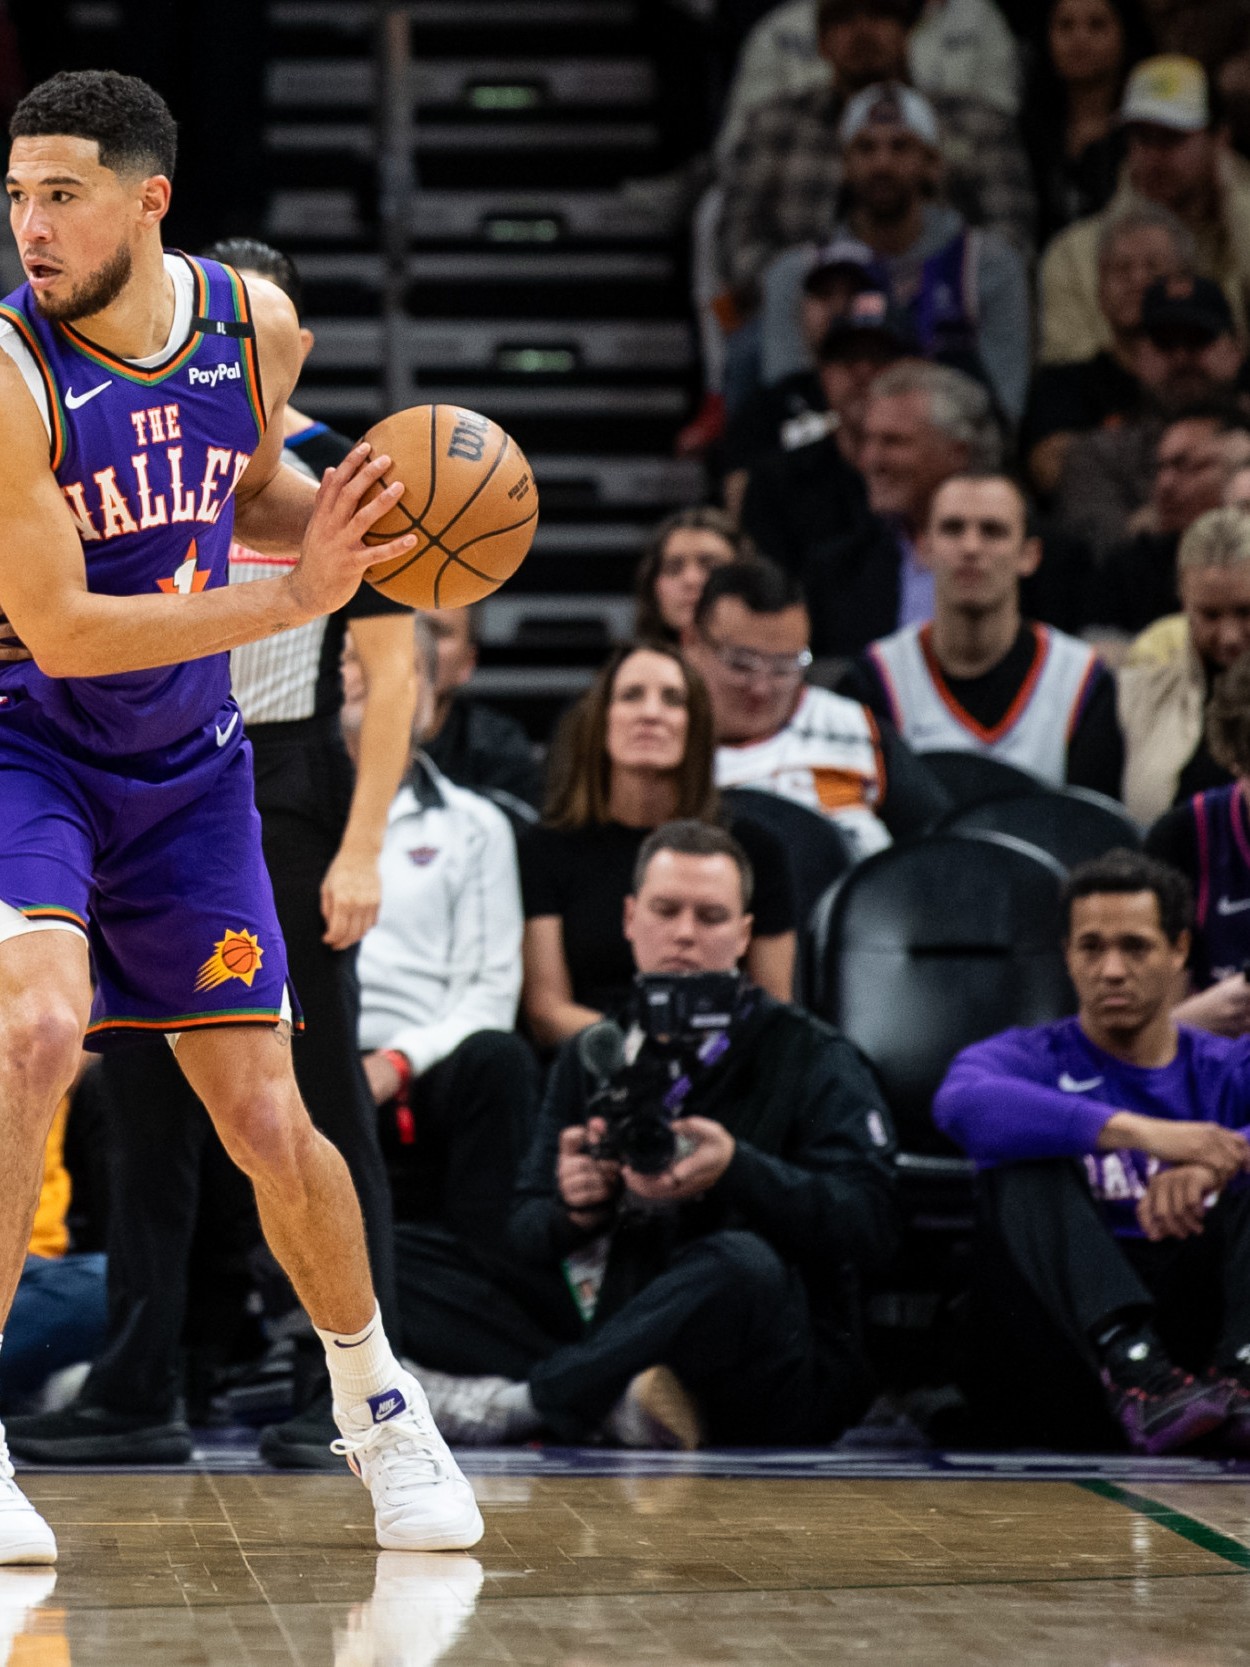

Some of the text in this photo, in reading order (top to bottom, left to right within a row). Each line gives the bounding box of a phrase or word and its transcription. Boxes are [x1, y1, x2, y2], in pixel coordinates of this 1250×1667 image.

[188, 361, 241, 387] PayPal
[130, 403, 182, 447] THE
[173, 557, 197, 595] 1
